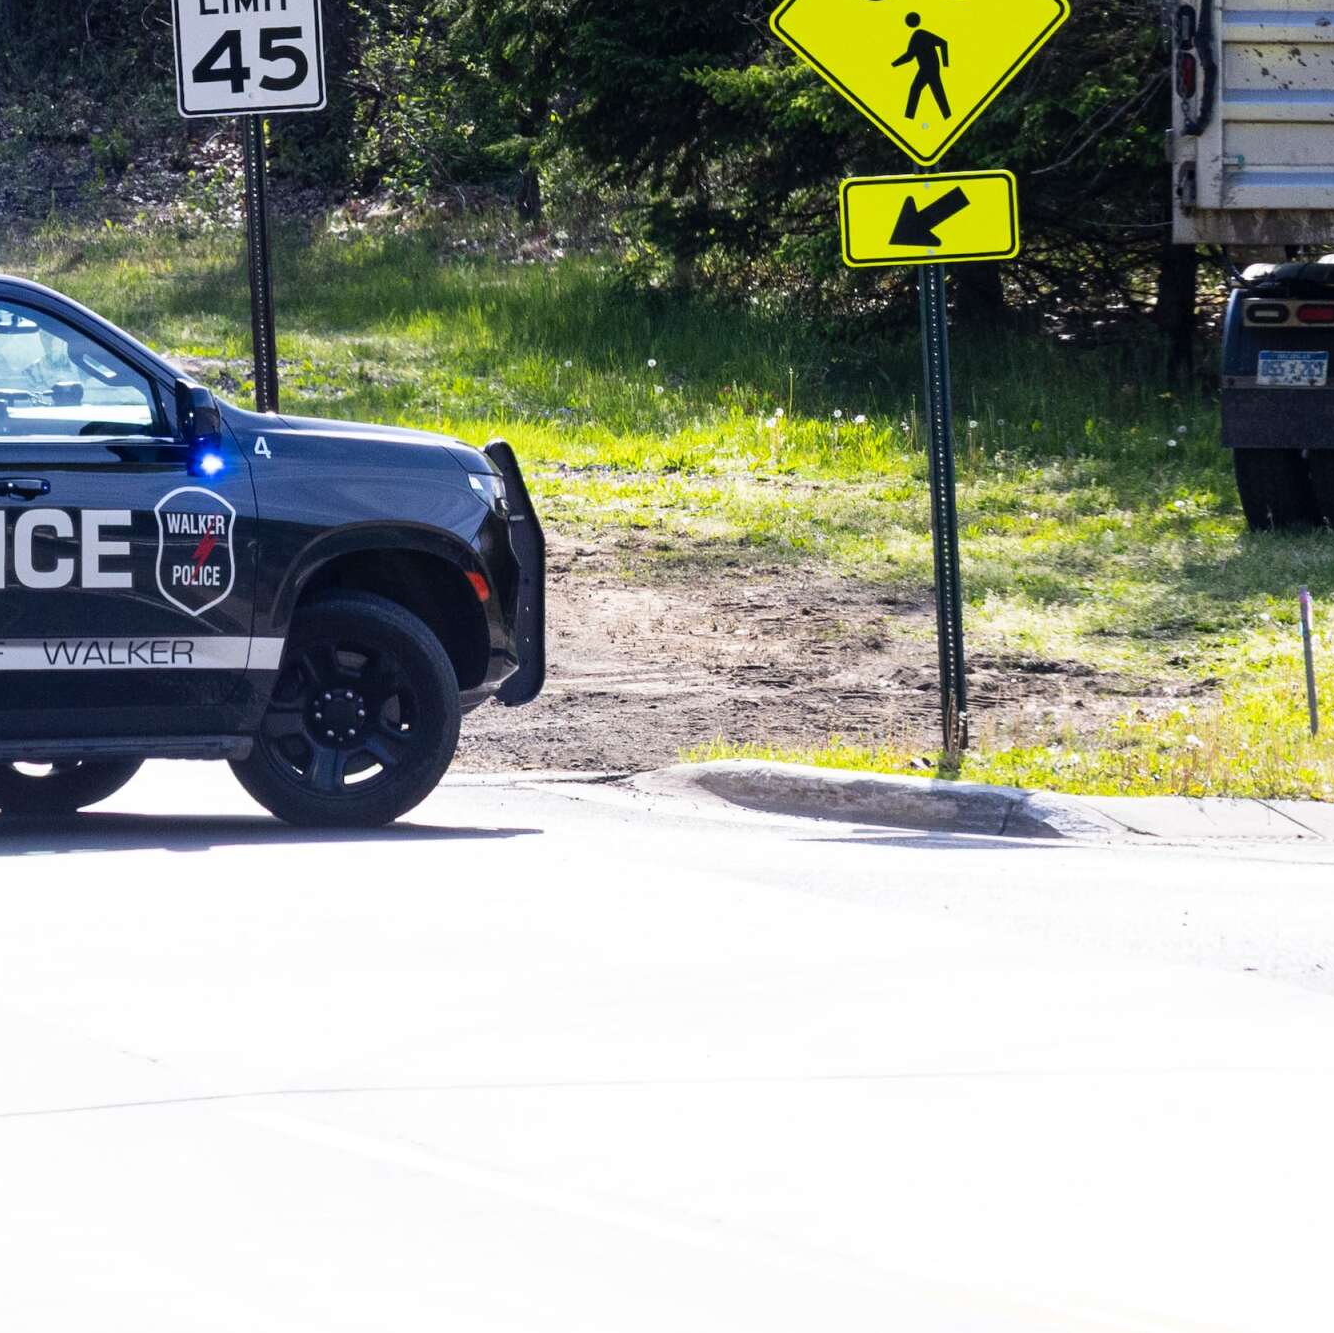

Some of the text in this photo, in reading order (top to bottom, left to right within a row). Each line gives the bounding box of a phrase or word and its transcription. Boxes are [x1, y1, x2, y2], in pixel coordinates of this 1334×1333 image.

[192, 25, 309, 94] 45
[254, 436, 272, 459] 4
[166, 513, 226, 535] WALKER
[172, 565, 221, 586] POLICE
[43, 640, 194, 665] WALKER
